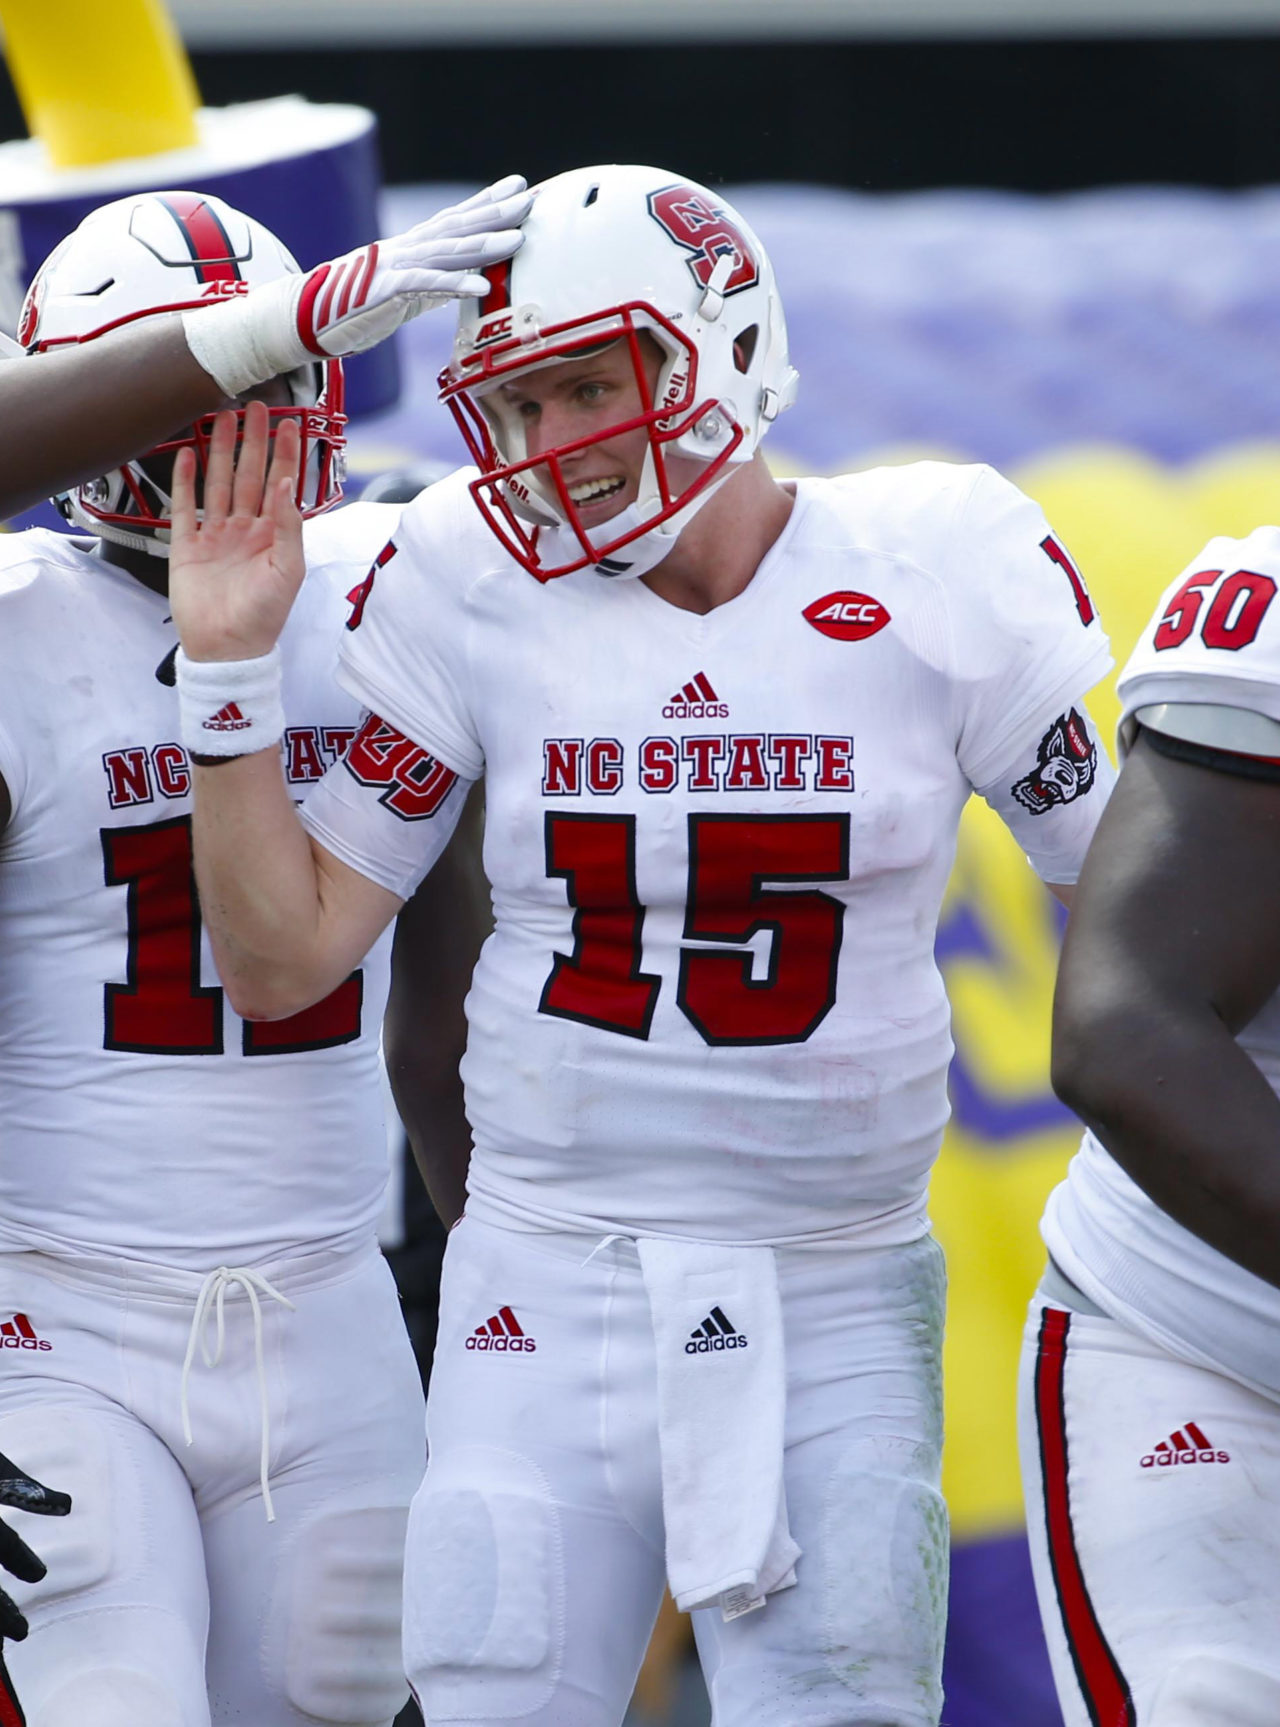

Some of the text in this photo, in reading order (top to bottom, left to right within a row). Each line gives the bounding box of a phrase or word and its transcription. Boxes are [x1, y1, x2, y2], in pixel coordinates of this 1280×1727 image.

[201, 280, 249, 297] ACC
[475, 315, 513, 342] ACC
[813, 602, 880, 622] ACC
[1153, 569, 1278, 651] 50
[661, 698, 730, 719] adidas
[201, 718, 253, 731] adidas
[103, 743, 191, 809] NC
[542, 733, 855, 797] NC STATE
[537, 811, 851, 1047] 15
[465, 1332, 537, 1353] adidas
[684, 1331, 748, 1355] adidas
[1139, 1447, 1231, 1468] adidas
